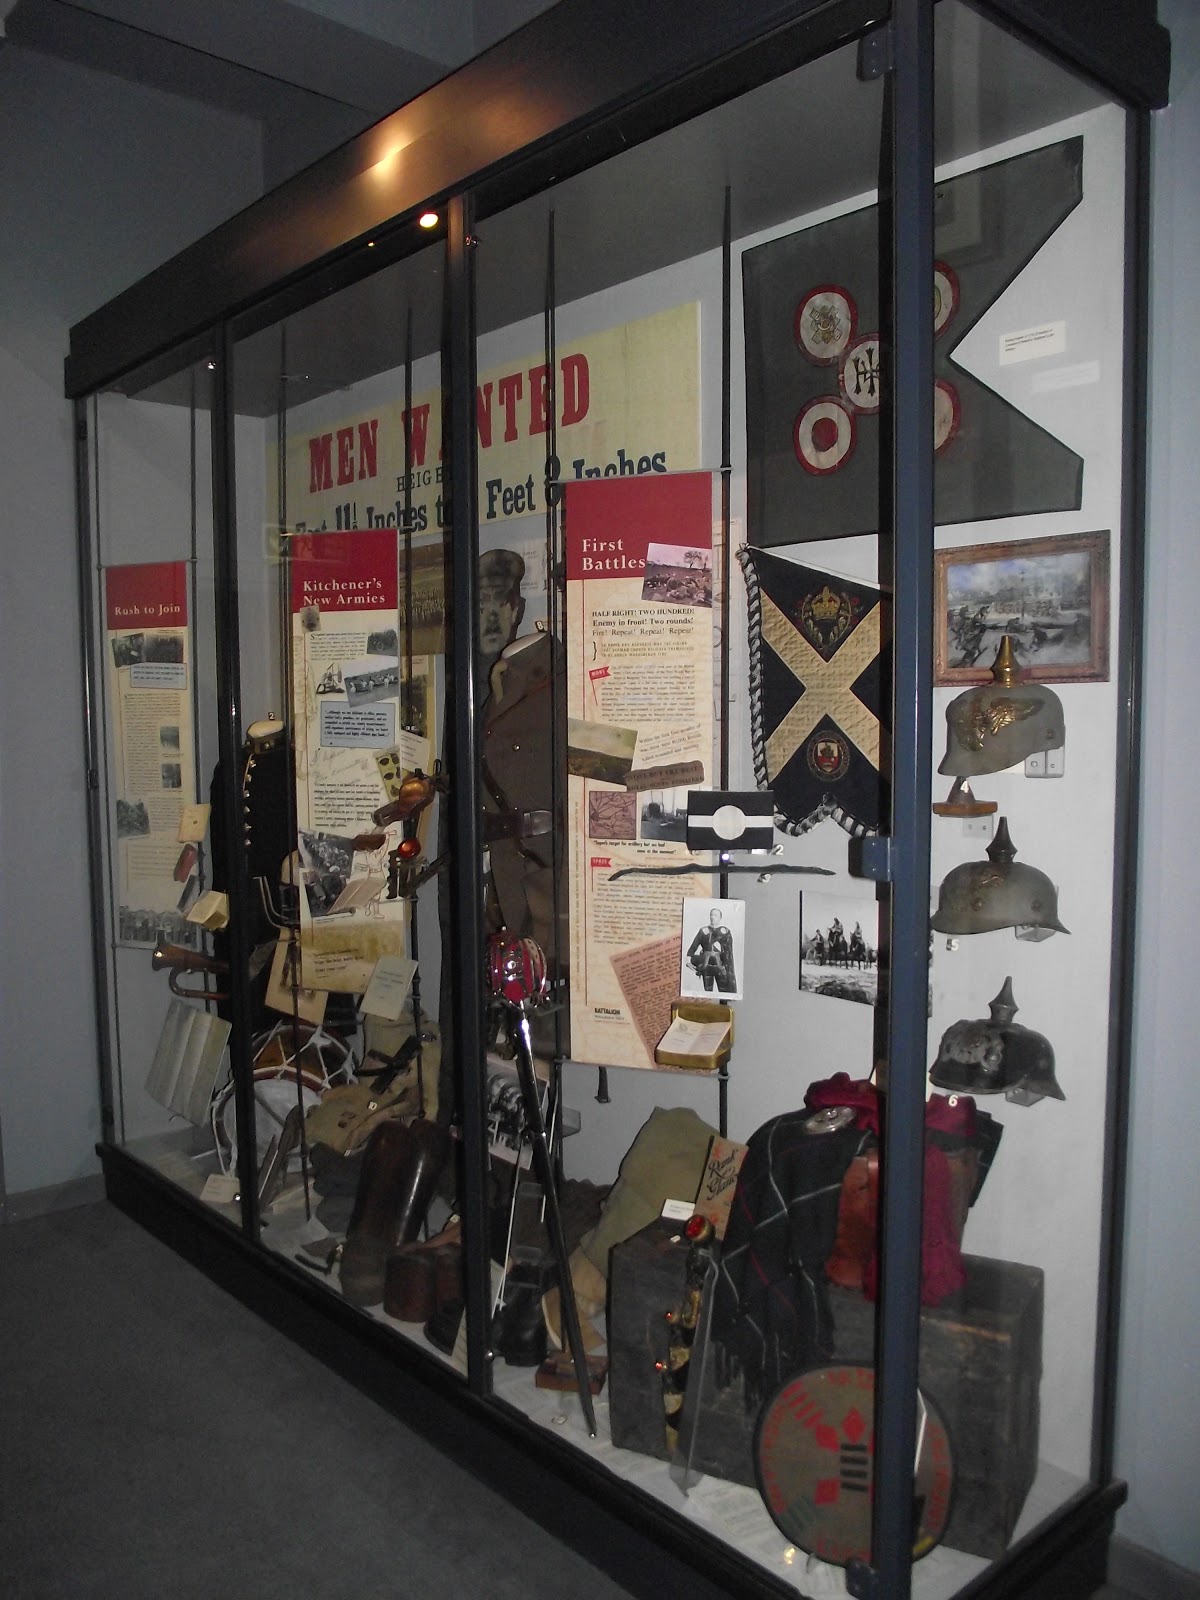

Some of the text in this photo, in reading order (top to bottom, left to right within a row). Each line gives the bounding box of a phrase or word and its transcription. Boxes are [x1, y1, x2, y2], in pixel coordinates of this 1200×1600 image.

[309, 353, 590, 494] MEN WNTED
[486, 474, 536, 519] Feet
[582, 538, 624, 553] First
[582, 554, 646, 571] Battles
[303, 577, 382, 592] Kitchener's
[303, 592, 386, 606] New Armies
[115, 603, 180, 616] Rush to Join
[593, 619, 617, 627] Enemy
[627, 618, 648, 626] front!
[611, 629, 636, 637] Repeat!
[640, 628, 665, 636] Repeat!
[669, 627, 694, 635] Repeat!
[960, 780, 970, 794] 4
[775, 844, 784, 856] 2
[951, 938, 960, 952] 5
[948, 1094, 959, 1107] 6
